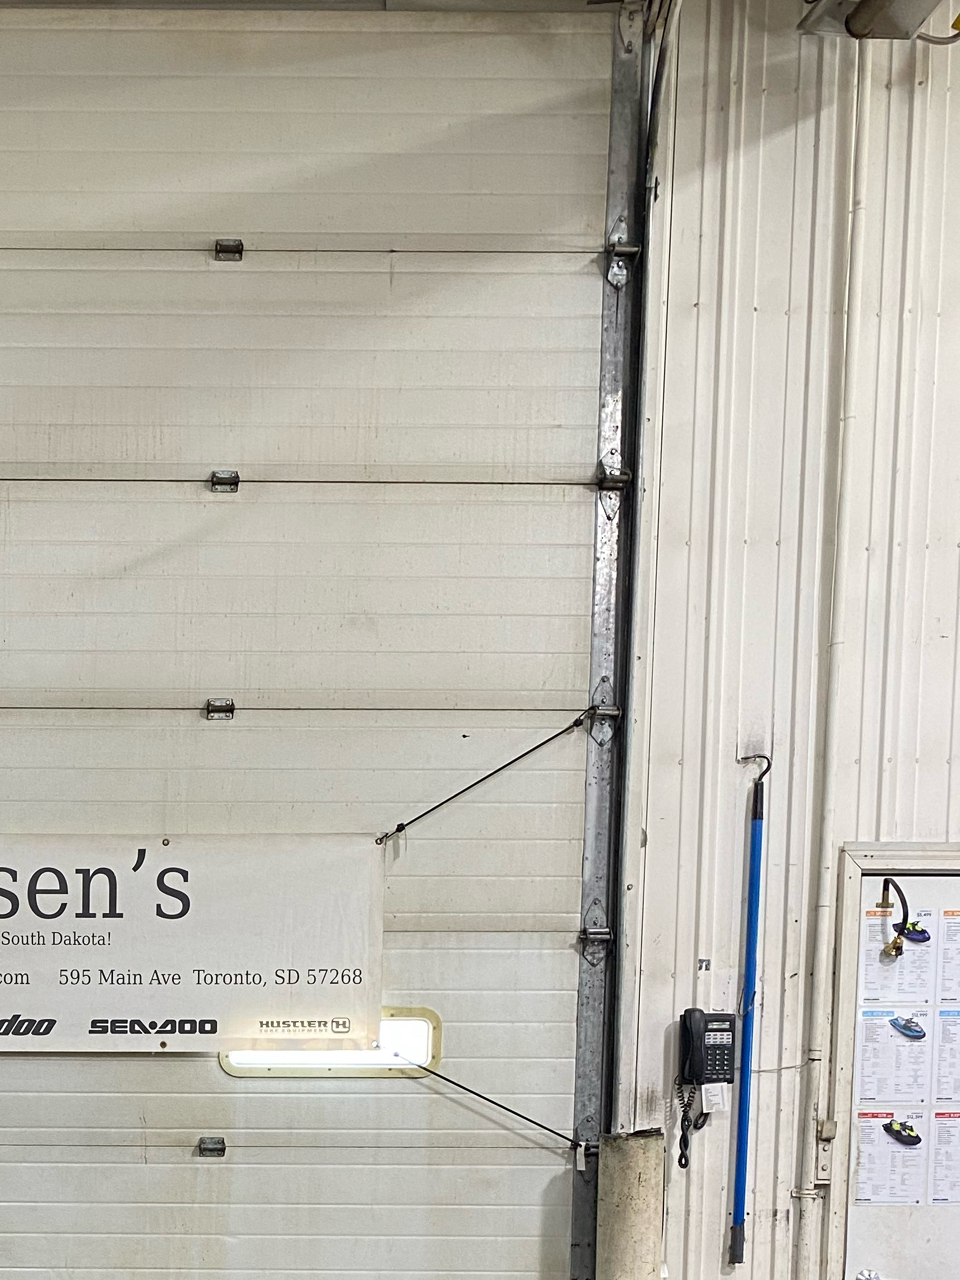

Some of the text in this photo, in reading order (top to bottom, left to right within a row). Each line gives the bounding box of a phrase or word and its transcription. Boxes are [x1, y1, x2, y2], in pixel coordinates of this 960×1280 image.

[2, 931, 45, 945] South
[52, 930, 111, 946] Dakota!
[59, 968, 91, 985] 595
[98, 969, 142, 985] Main
[148, 969, 182, 985] Ave
[193, 969, 267, 988] Toronto,
[274, 969, 299, 985] SD
[306, 968, 363, 985] 57268
[259, 1020, 328, 1028] HUSTLER
